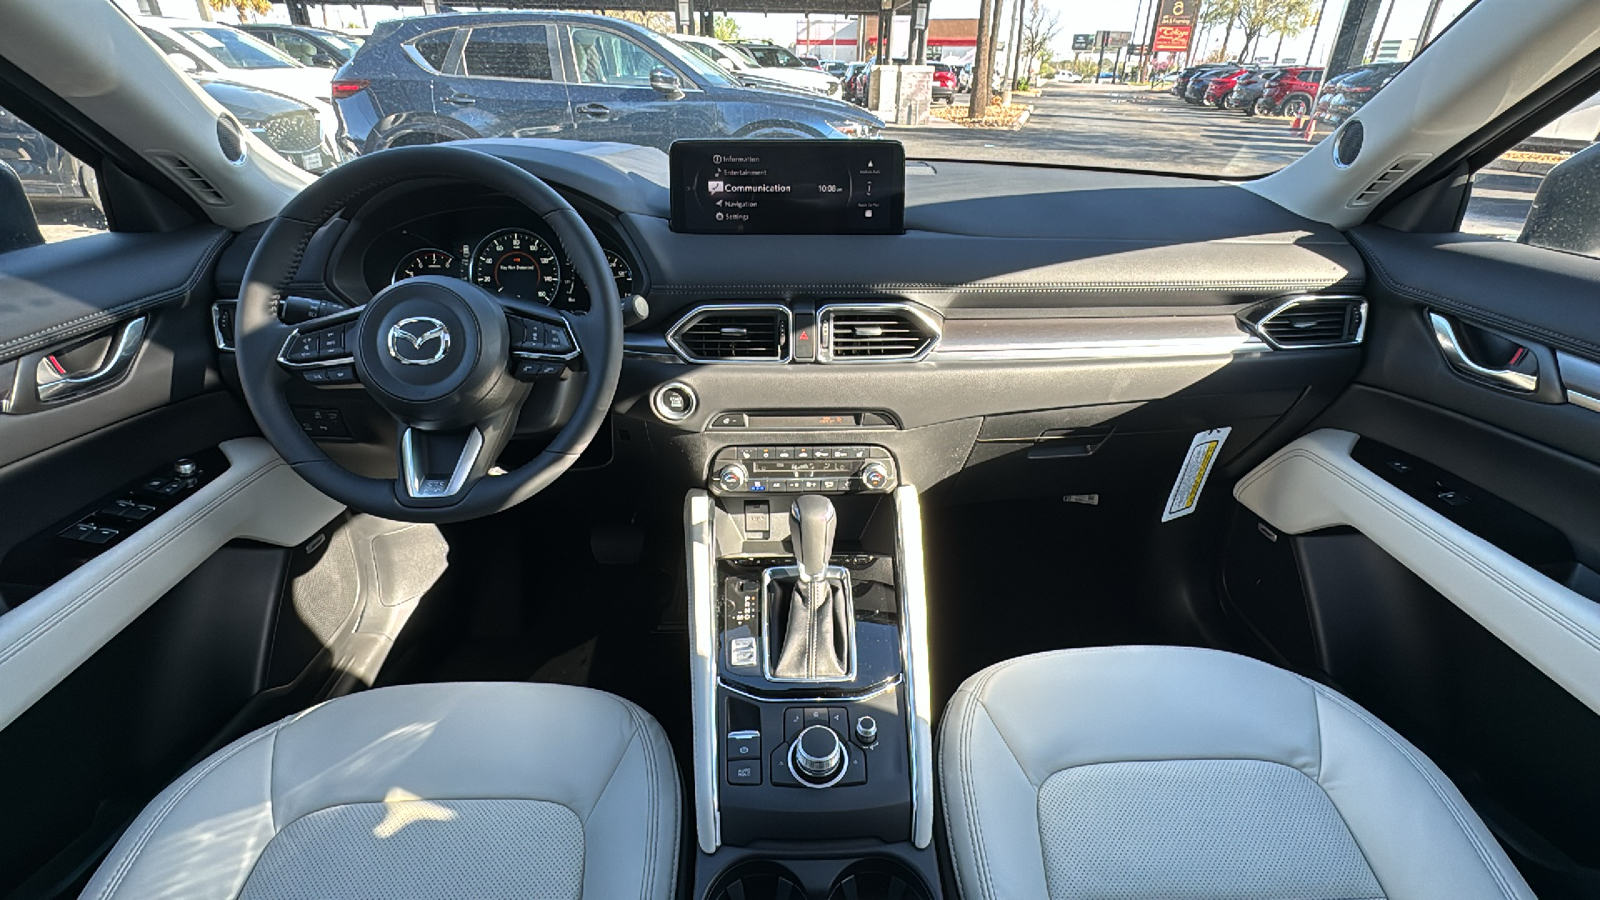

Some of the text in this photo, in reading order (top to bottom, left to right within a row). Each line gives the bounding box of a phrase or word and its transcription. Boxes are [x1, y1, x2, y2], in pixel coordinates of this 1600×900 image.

[724, 184, 791, 193] Communication
[725, 201, 757, 209] Navigation
[725, 213, 749, 221] Settings
